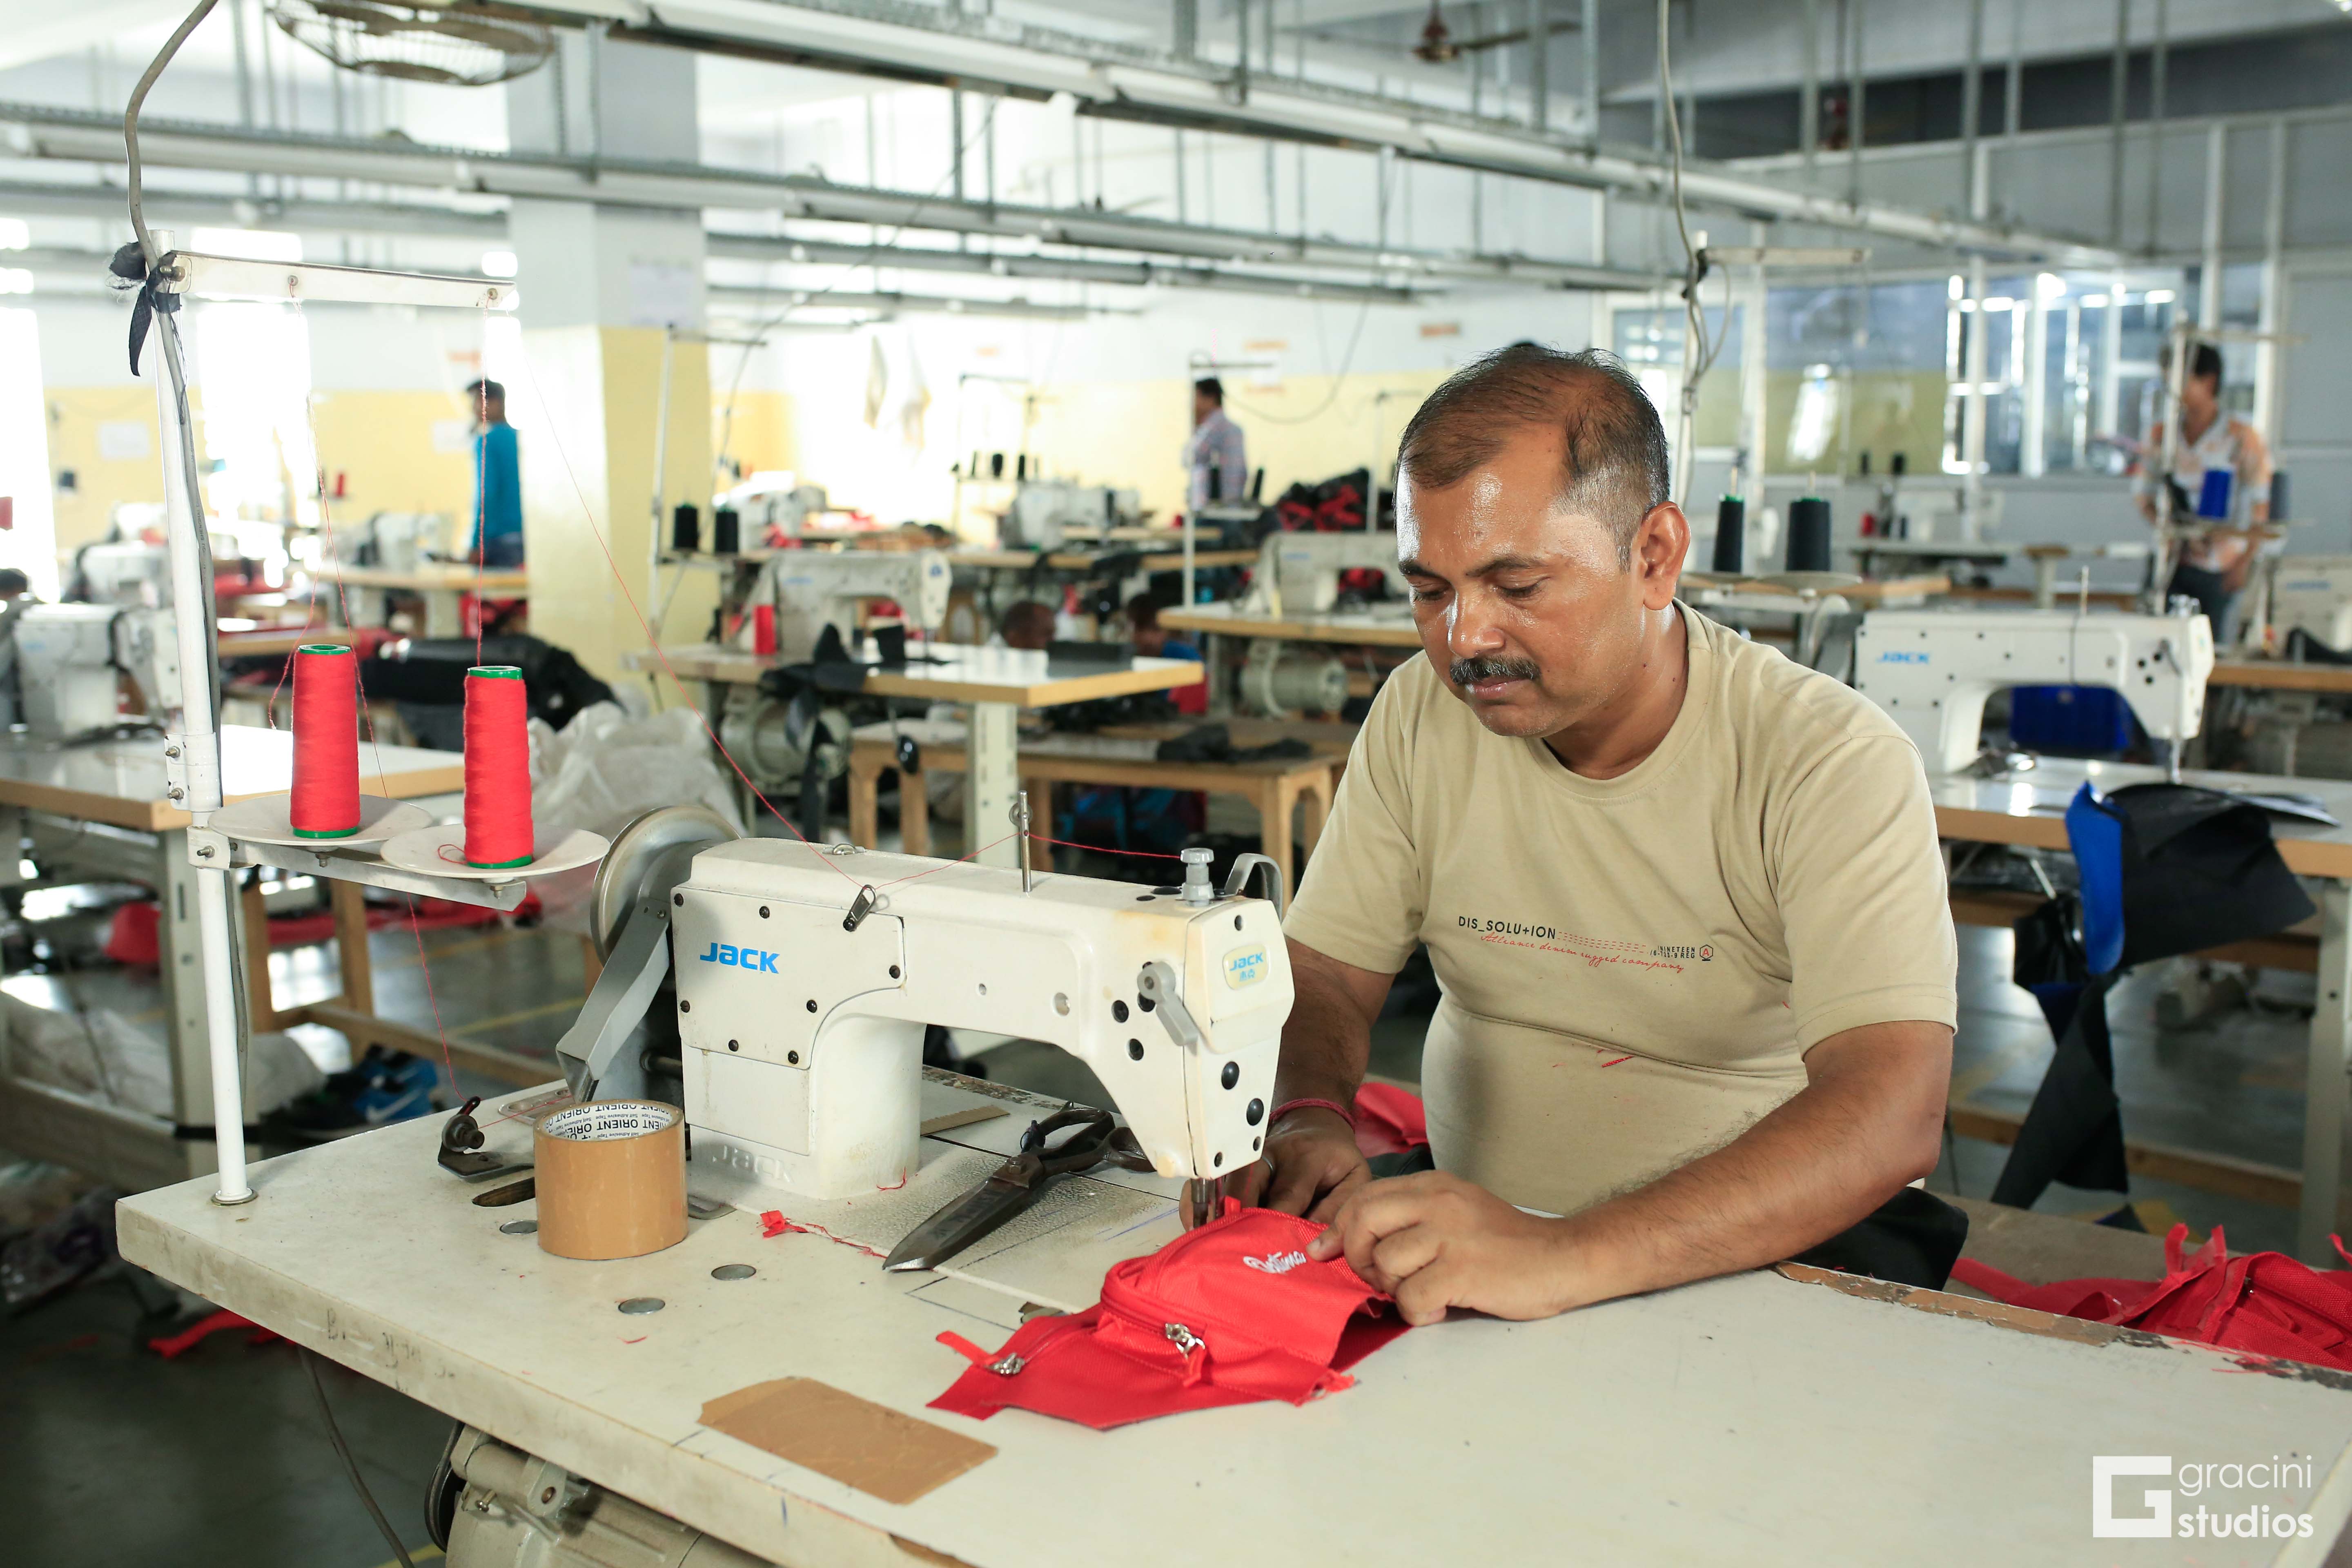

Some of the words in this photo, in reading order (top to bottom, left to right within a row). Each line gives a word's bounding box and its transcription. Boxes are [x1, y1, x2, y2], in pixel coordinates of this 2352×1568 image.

[1539, 942, 1577, 955] denim
[1581, 952, 1621, 967] rugged
[1622, 958, 1684, 973] company
[597, 1119, 638, 1130] ORIENT
